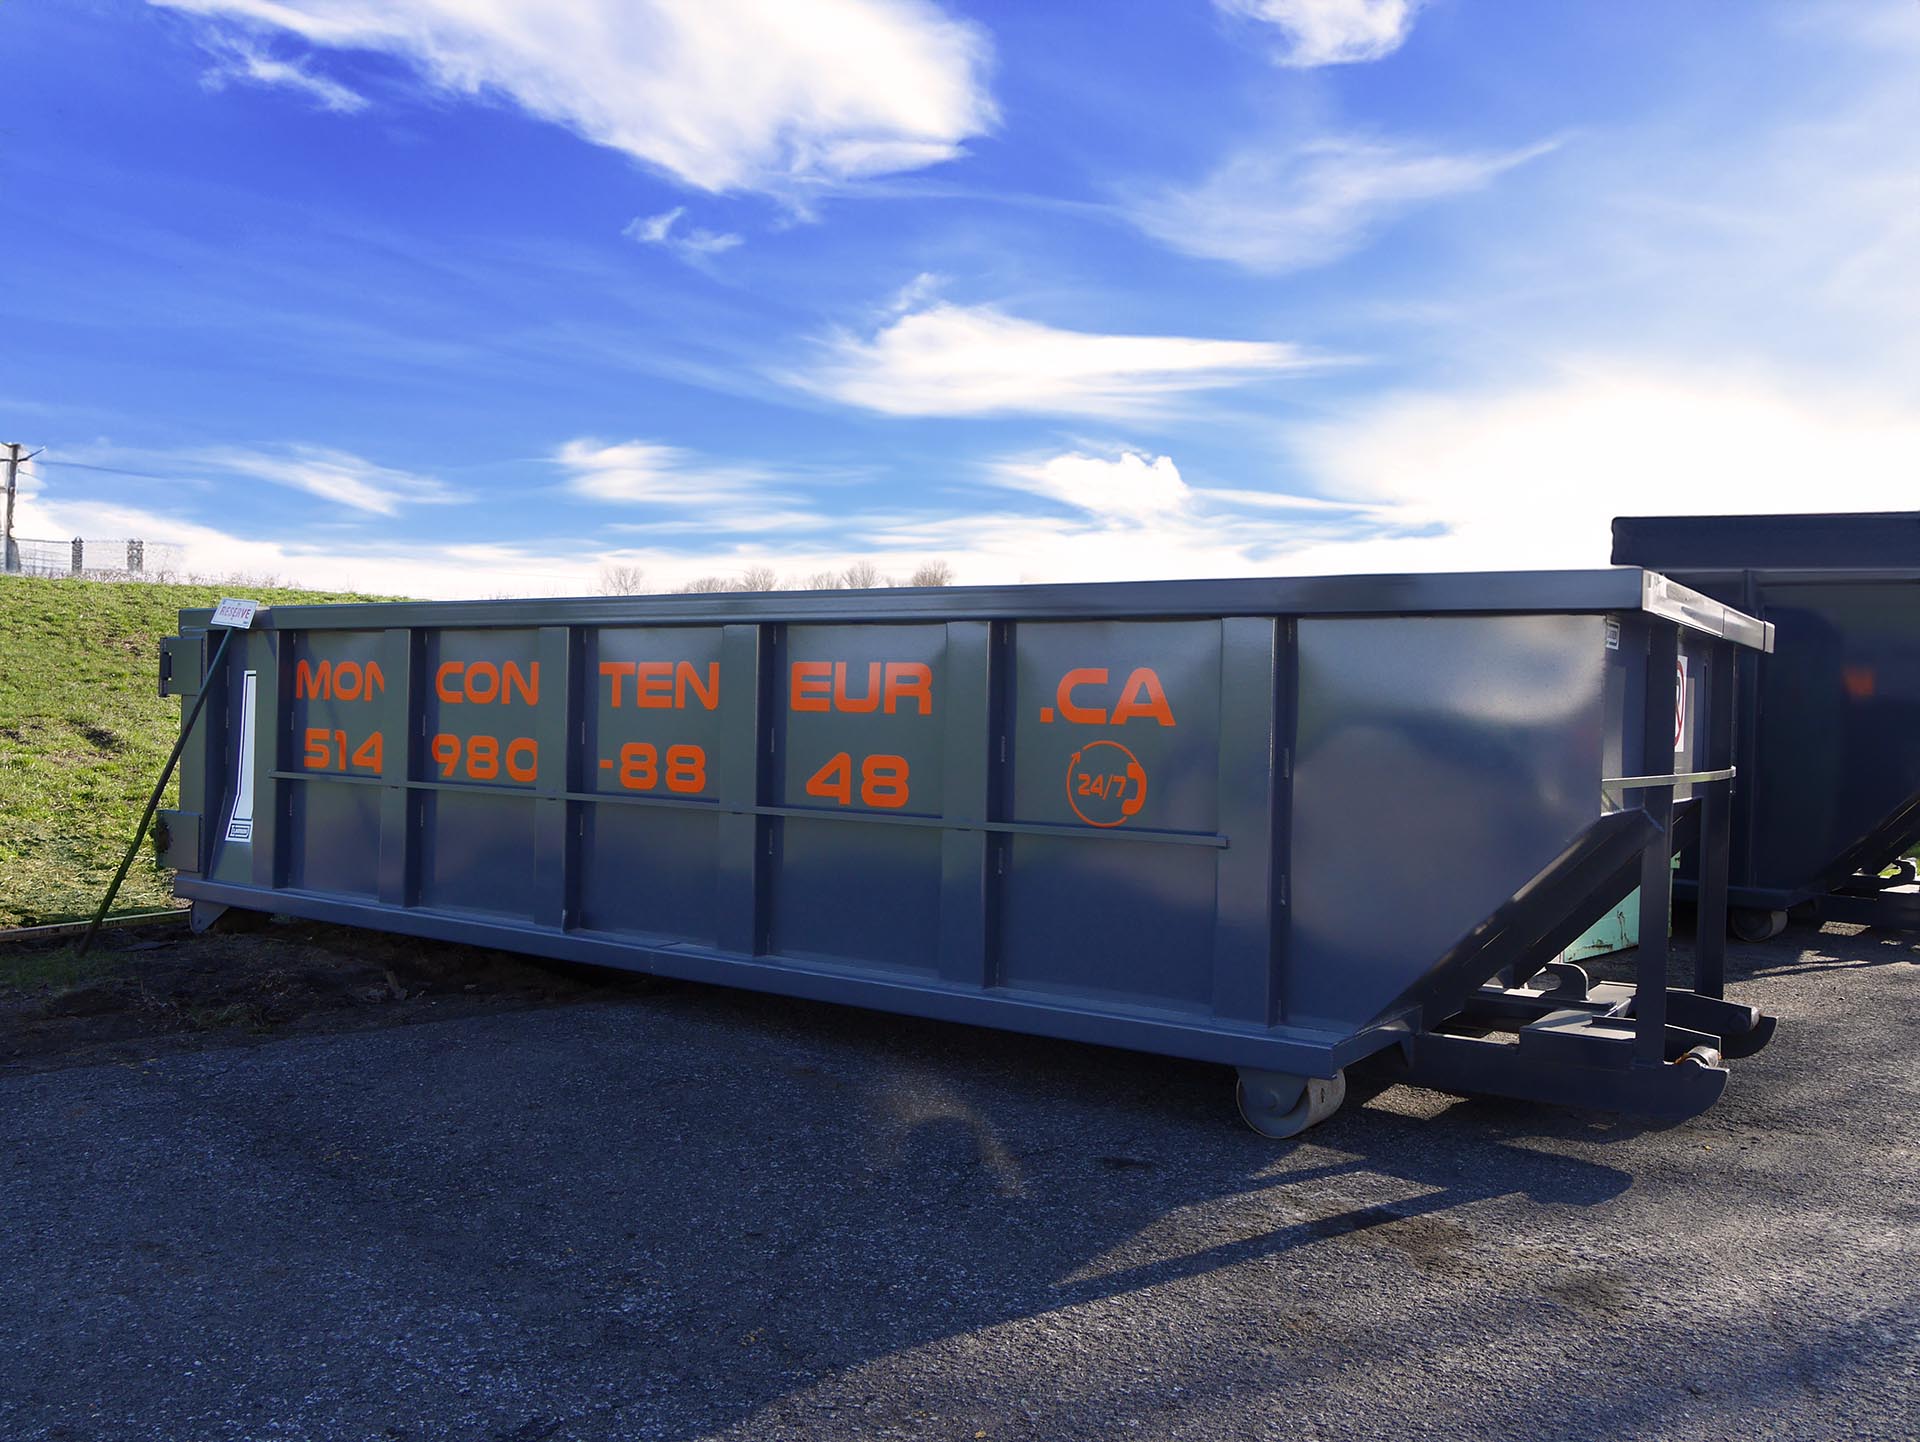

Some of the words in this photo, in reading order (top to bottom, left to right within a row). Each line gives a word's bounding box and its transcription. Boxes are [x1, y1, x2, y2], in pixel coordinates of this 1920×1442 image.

[219, 605, 252, 619] RESERVE
[436, 661, 539, 705] CON
[600, 662, 720, 710] TEN
[791, 663, 932, 715] EUR
[1040, 668, 1175, 726] .CA
[304, 728, 384, 773] 514
[432, 734, 538, 782] 980
[598, 743, 706, 793] -88
[806, 752, 909, 808] 48
[1077, 773, 1126, 800] 24/7
